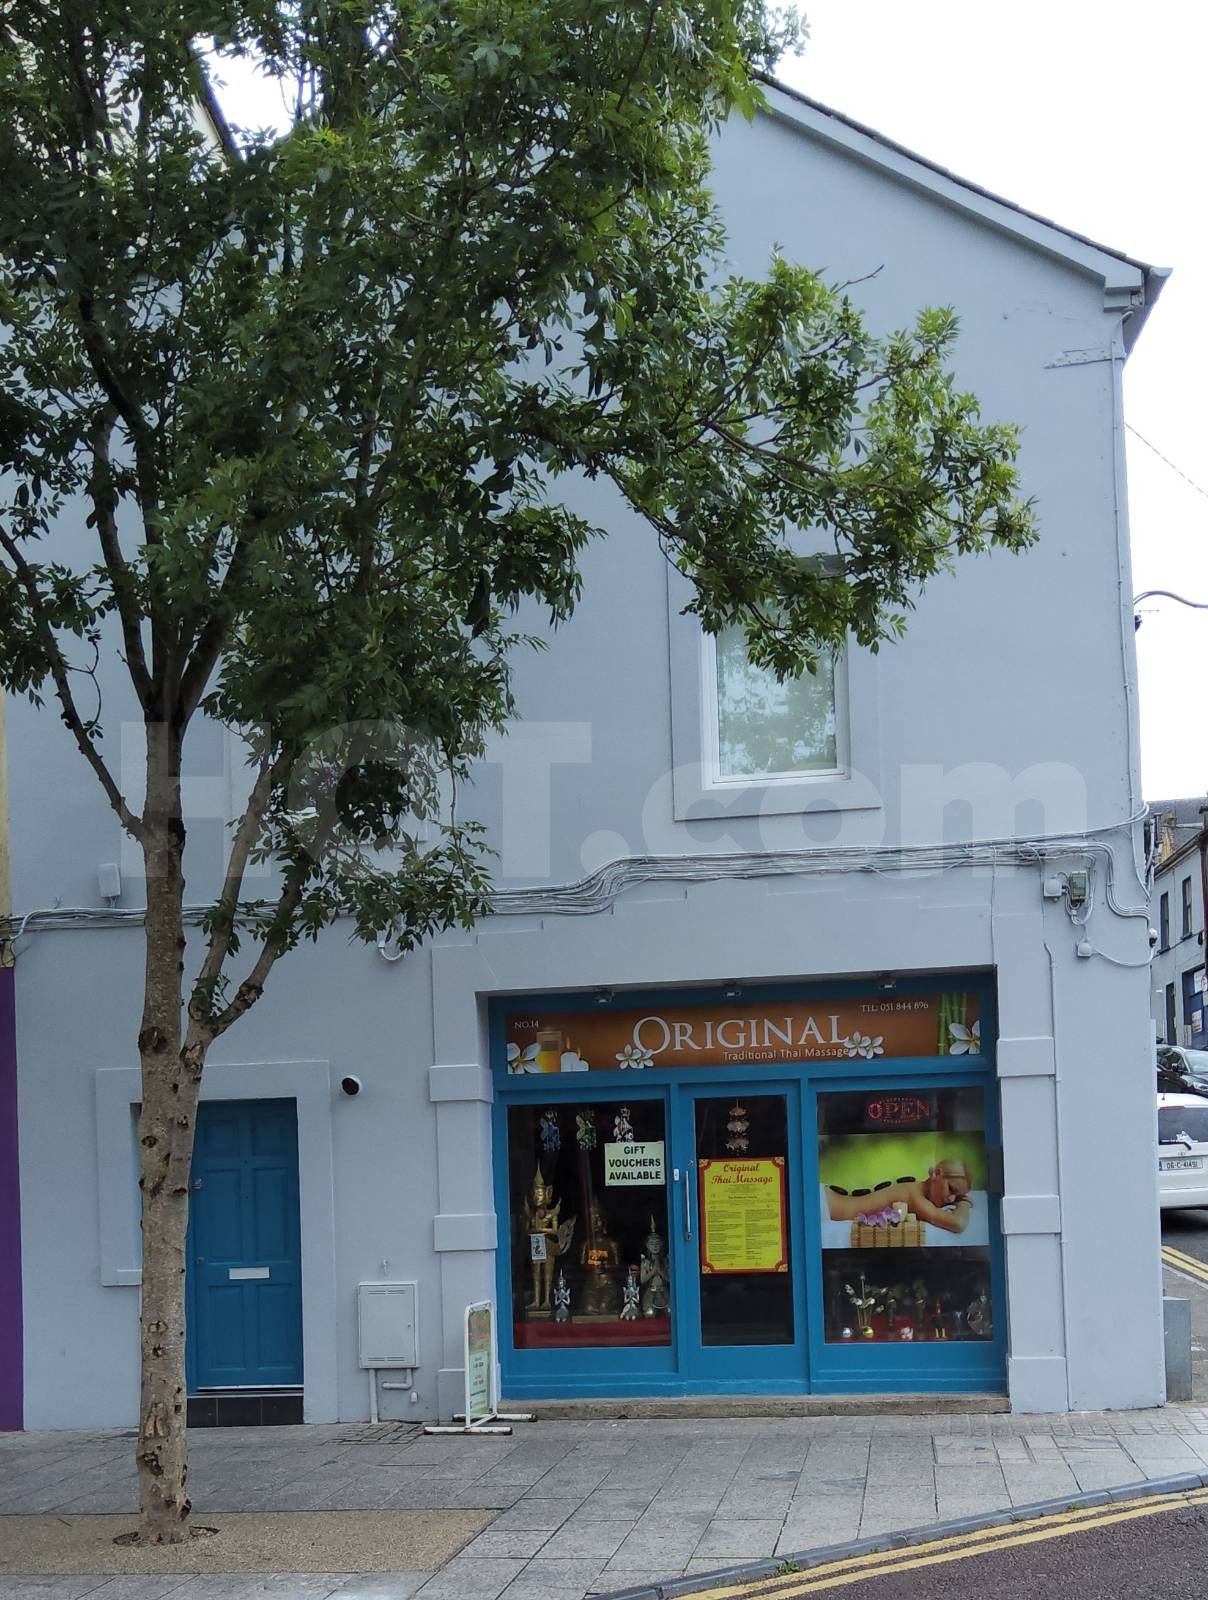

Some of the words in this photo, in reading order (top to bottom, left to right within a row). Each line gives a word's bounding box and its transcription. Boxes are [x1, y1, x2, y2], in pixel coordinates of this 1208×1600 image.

[632, 1014, 850, 1055] ORIGINAL
[723, 1050, 777, 1062] Traditional
[781, 1048, 801, 1059] Thai
[805, 1046, 849, 1058] Massage
[867, 1101, 930, 1120] OPEN
[623, 1145, 646, 1155] GIFT
[608, 1158, 662, 1168] VOUCHERS
[723, 1162, 761, 1174] Original
[608, 1170, 662, 1180] AVAILABLE
[711, 1175, 732, 1185] Thai
[733, 1173, 774, 1185] Massage
